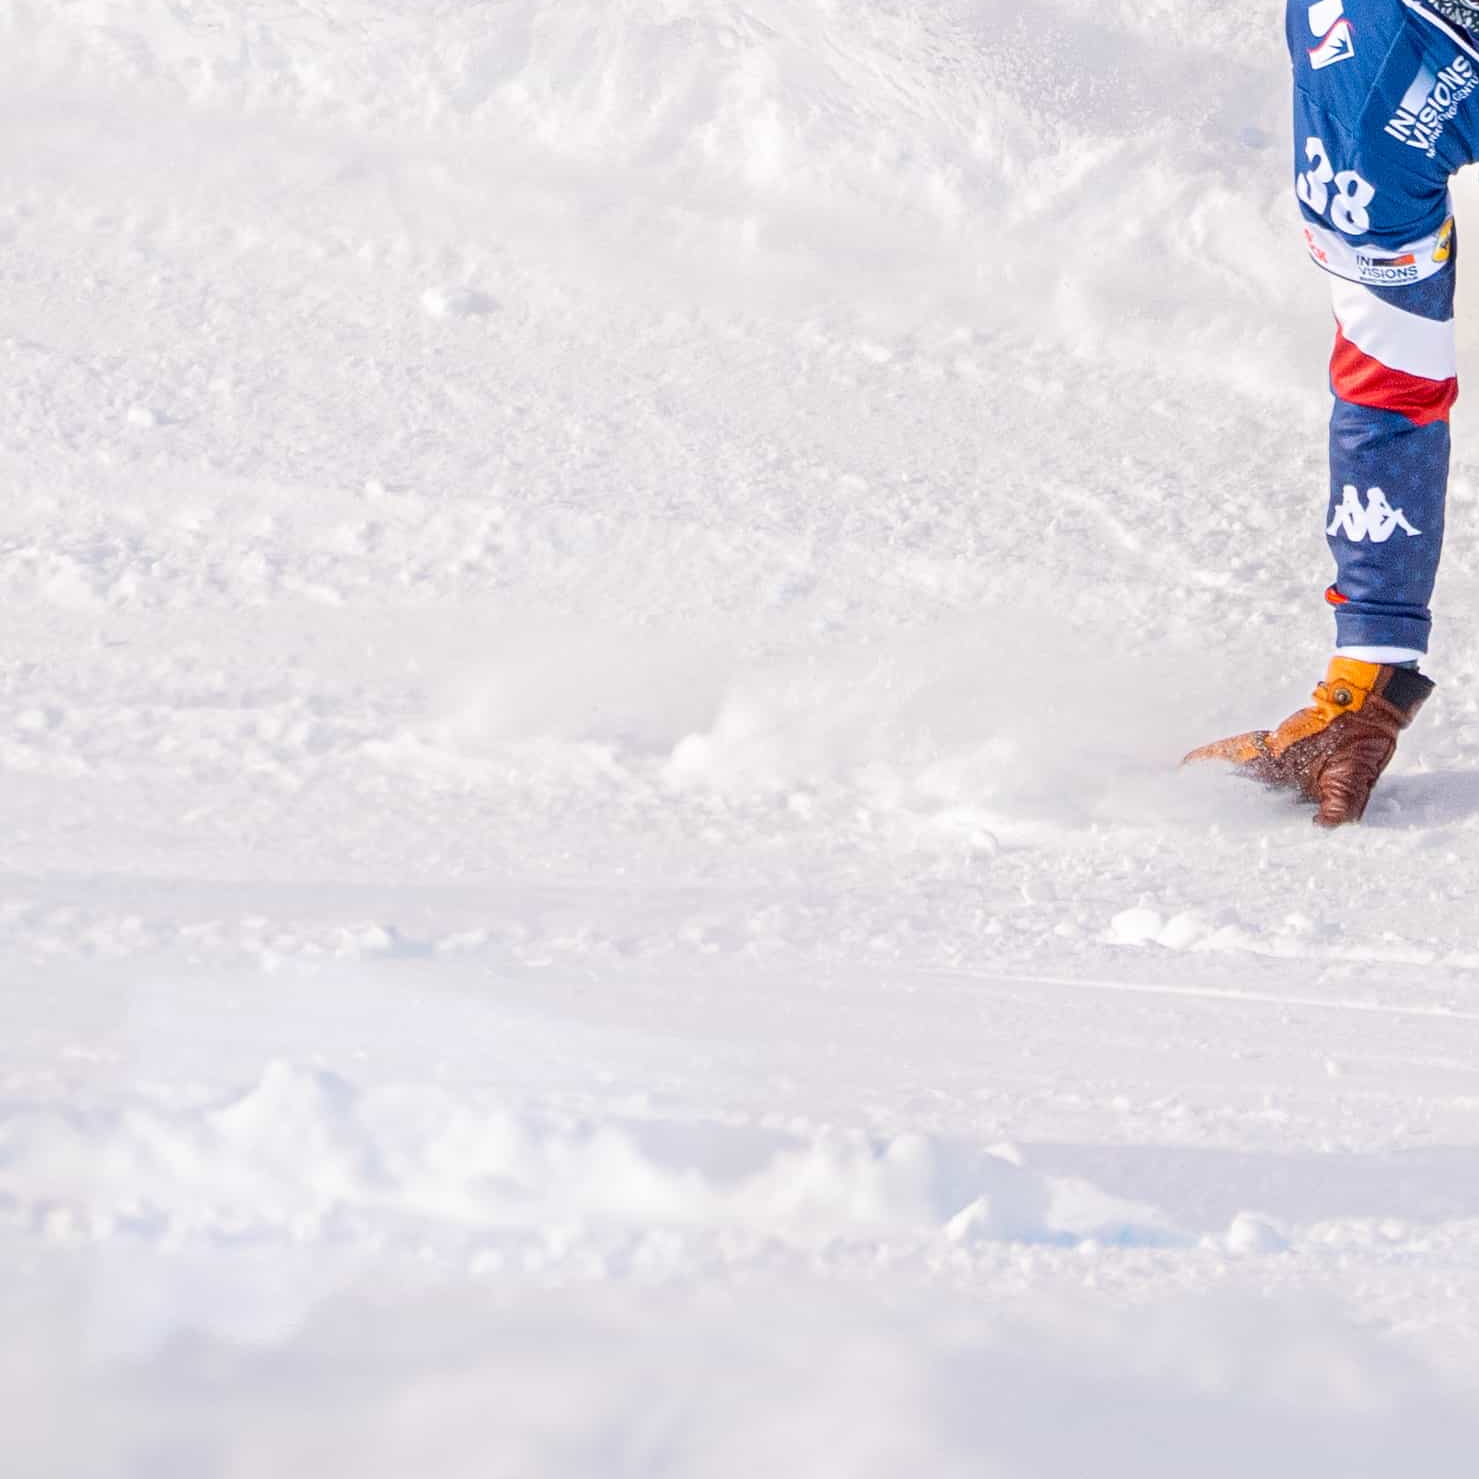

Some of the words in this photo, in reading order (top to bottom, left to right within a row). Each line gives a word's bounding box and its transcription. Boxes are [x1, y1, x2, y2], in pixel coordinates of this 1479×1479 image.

[1406, 55, 1474, 150] VISIONS
[1384, 108, 1417, 143] IN
[1296, 136, 1376, 236] 38
[1356, 254, 1371, 267] IN
[1359, 264, 1419, 280] VISIONS
